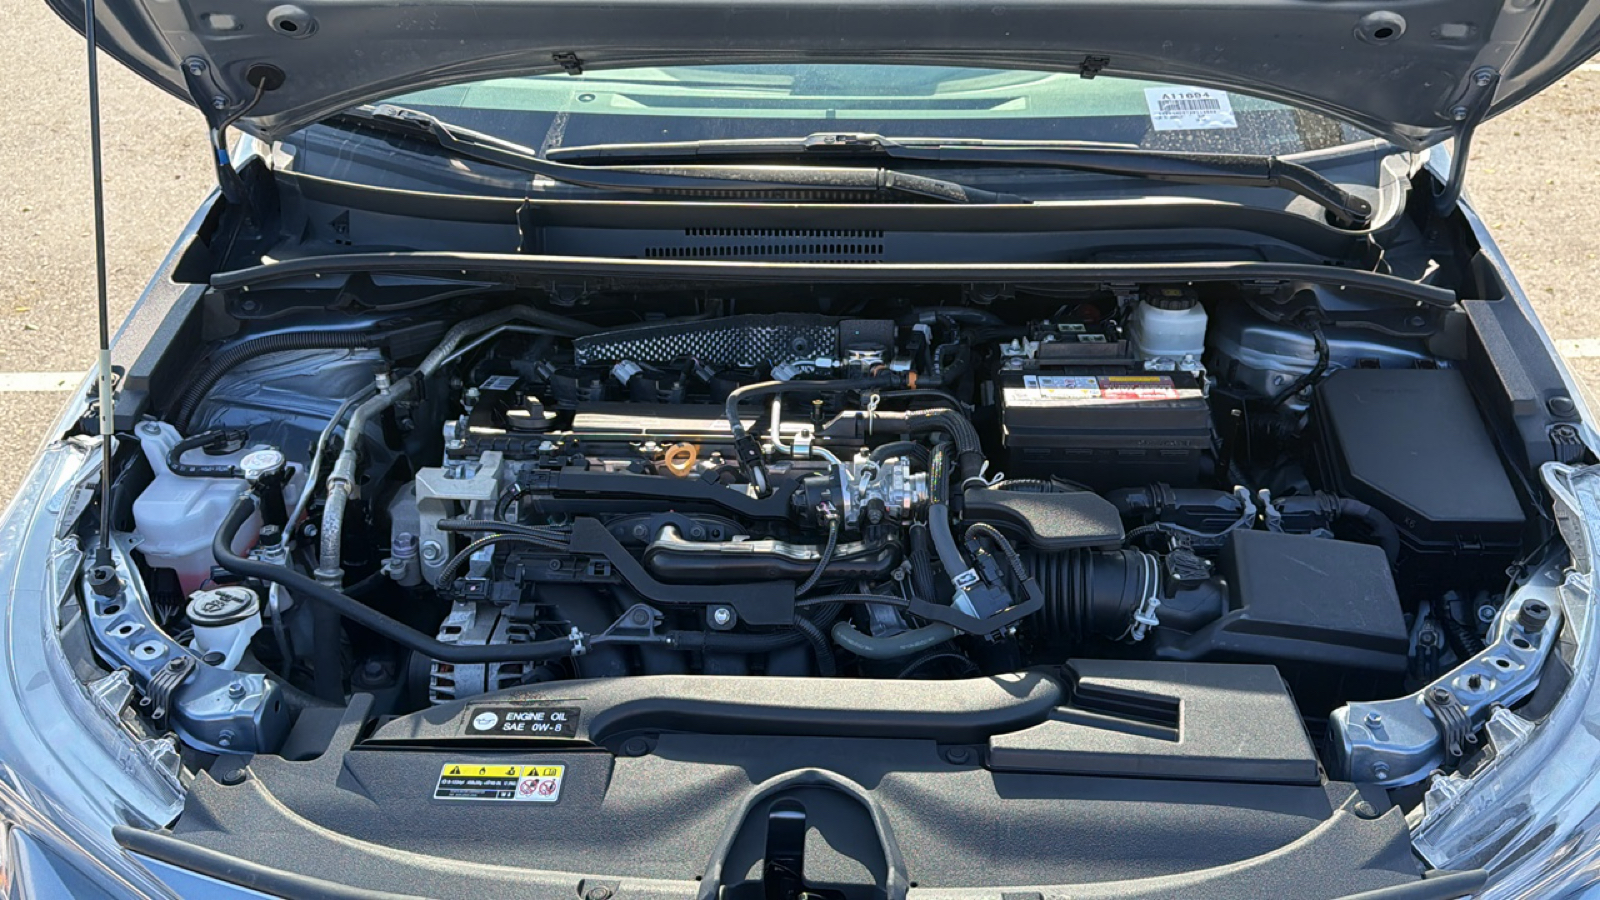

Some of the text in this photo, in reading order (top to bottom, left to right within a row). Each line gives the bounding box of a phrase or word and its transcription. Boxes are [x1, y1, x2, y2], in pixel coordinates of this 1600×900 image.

[505, 711, 567, 721] ENGINE OIL
[503, 722, 525, 731] SAE
